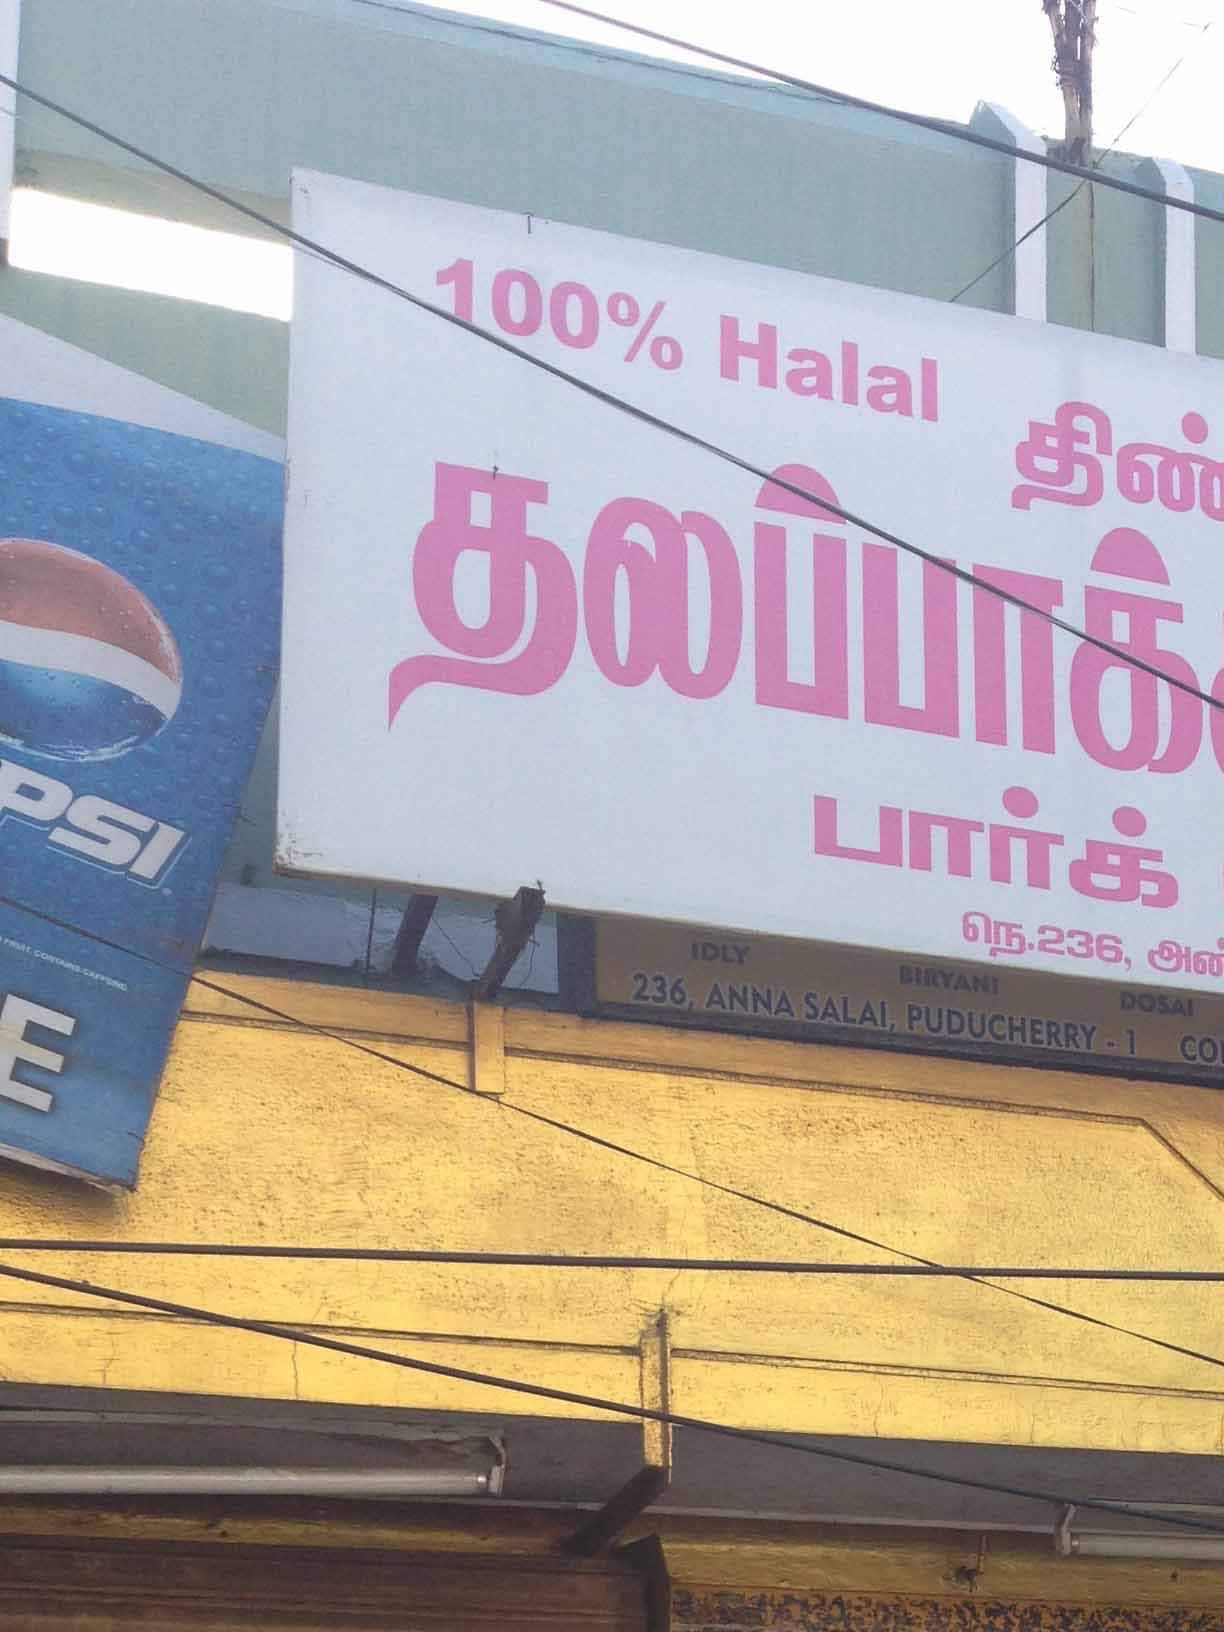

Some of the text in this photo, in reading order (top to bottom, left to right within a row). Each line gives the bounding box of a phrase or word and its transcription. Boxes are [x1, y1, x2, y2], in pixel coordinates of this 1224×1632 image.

[437, 259, 938, 422] 100% Halal
[814, 786, 1180, 910] பார்க்
[632, 972, 695, 1011] 236,
[705, 983, 795, 1018] ANNA
[803, 992, 896, 1033] SALAI,
[905, 1002, 1097, 1052] PUDUCHERRY
[690, 942, 1195, 1018] IDLY BIRYANI DOSAI
